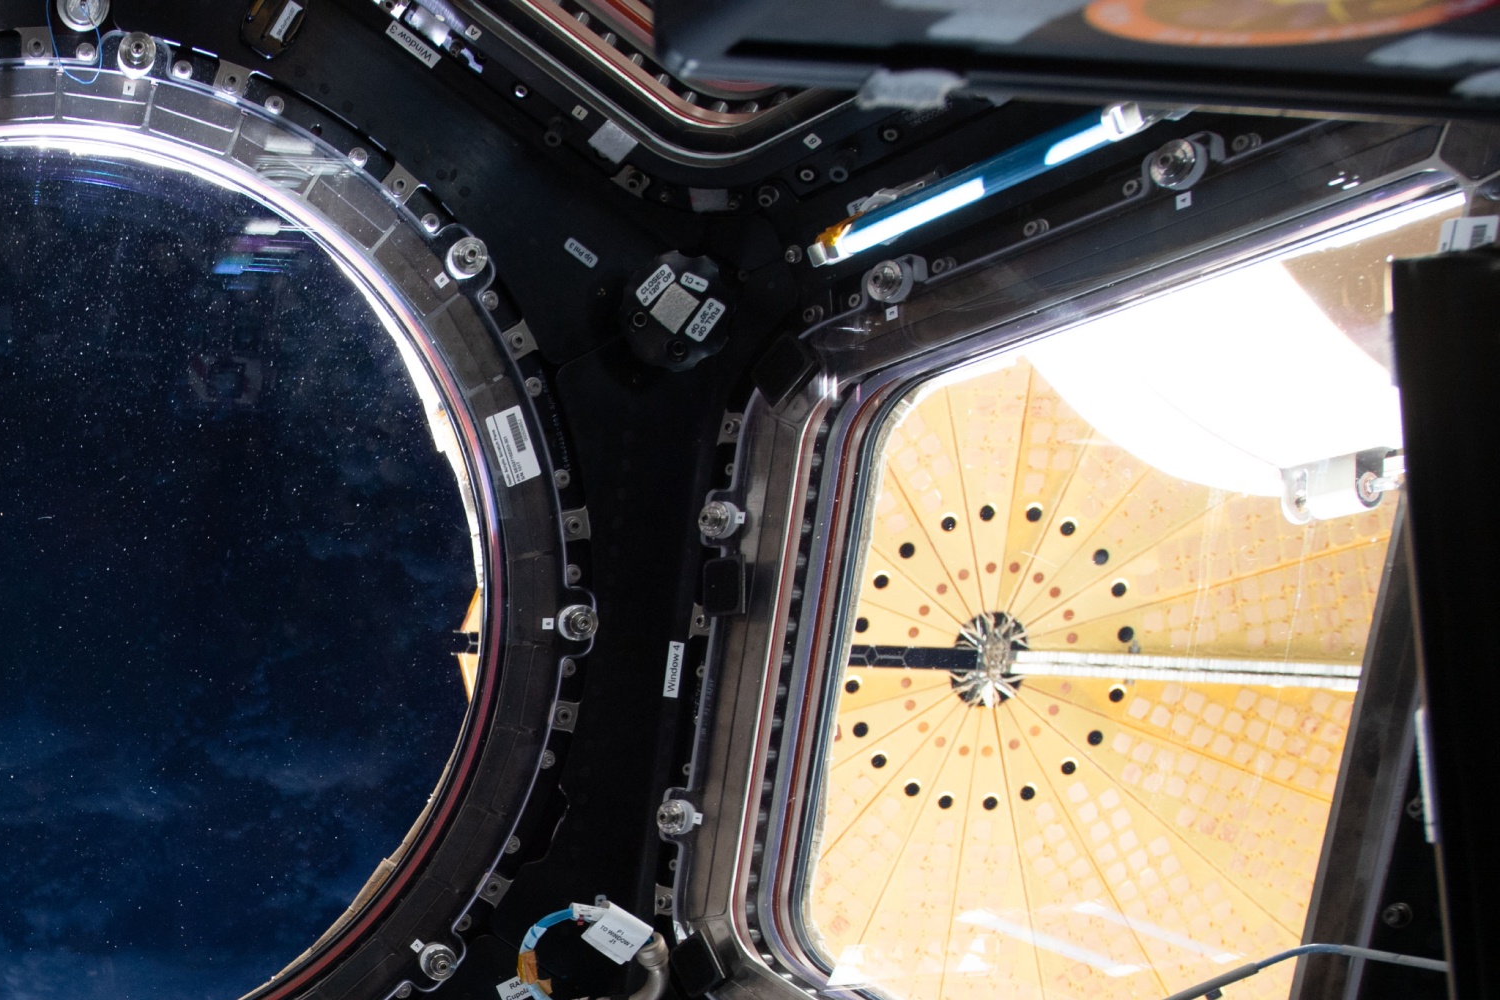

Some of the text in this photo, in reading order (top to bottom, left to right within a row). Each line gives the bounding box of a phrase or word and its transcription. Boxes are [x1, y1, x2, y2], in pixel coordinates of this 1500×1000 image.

[388, 23, 434, 61] Window 3
[571, 244, 585, 257] Pnl
[582, 252, 594, 263] Up
[639, 268, 666, 295] CLOSED
[682, 274, 694, 284] CL
[640, 294, 650, 303] or
[661, 271, 673, 283] OP
[706, 301, 715, 310] or
[689, 322, 700, 334] OP
[696, 306, 721, 337] FULL OP
[495, 441, 503, 457] Scratch
[500, 458, 508, 472] Acrylic
[666, 652, 679, 693] Window
[599, 924, 608, 932] TO
[606, 929, 628, 945] WINDOW
[616, 928, 624, 936] P1
